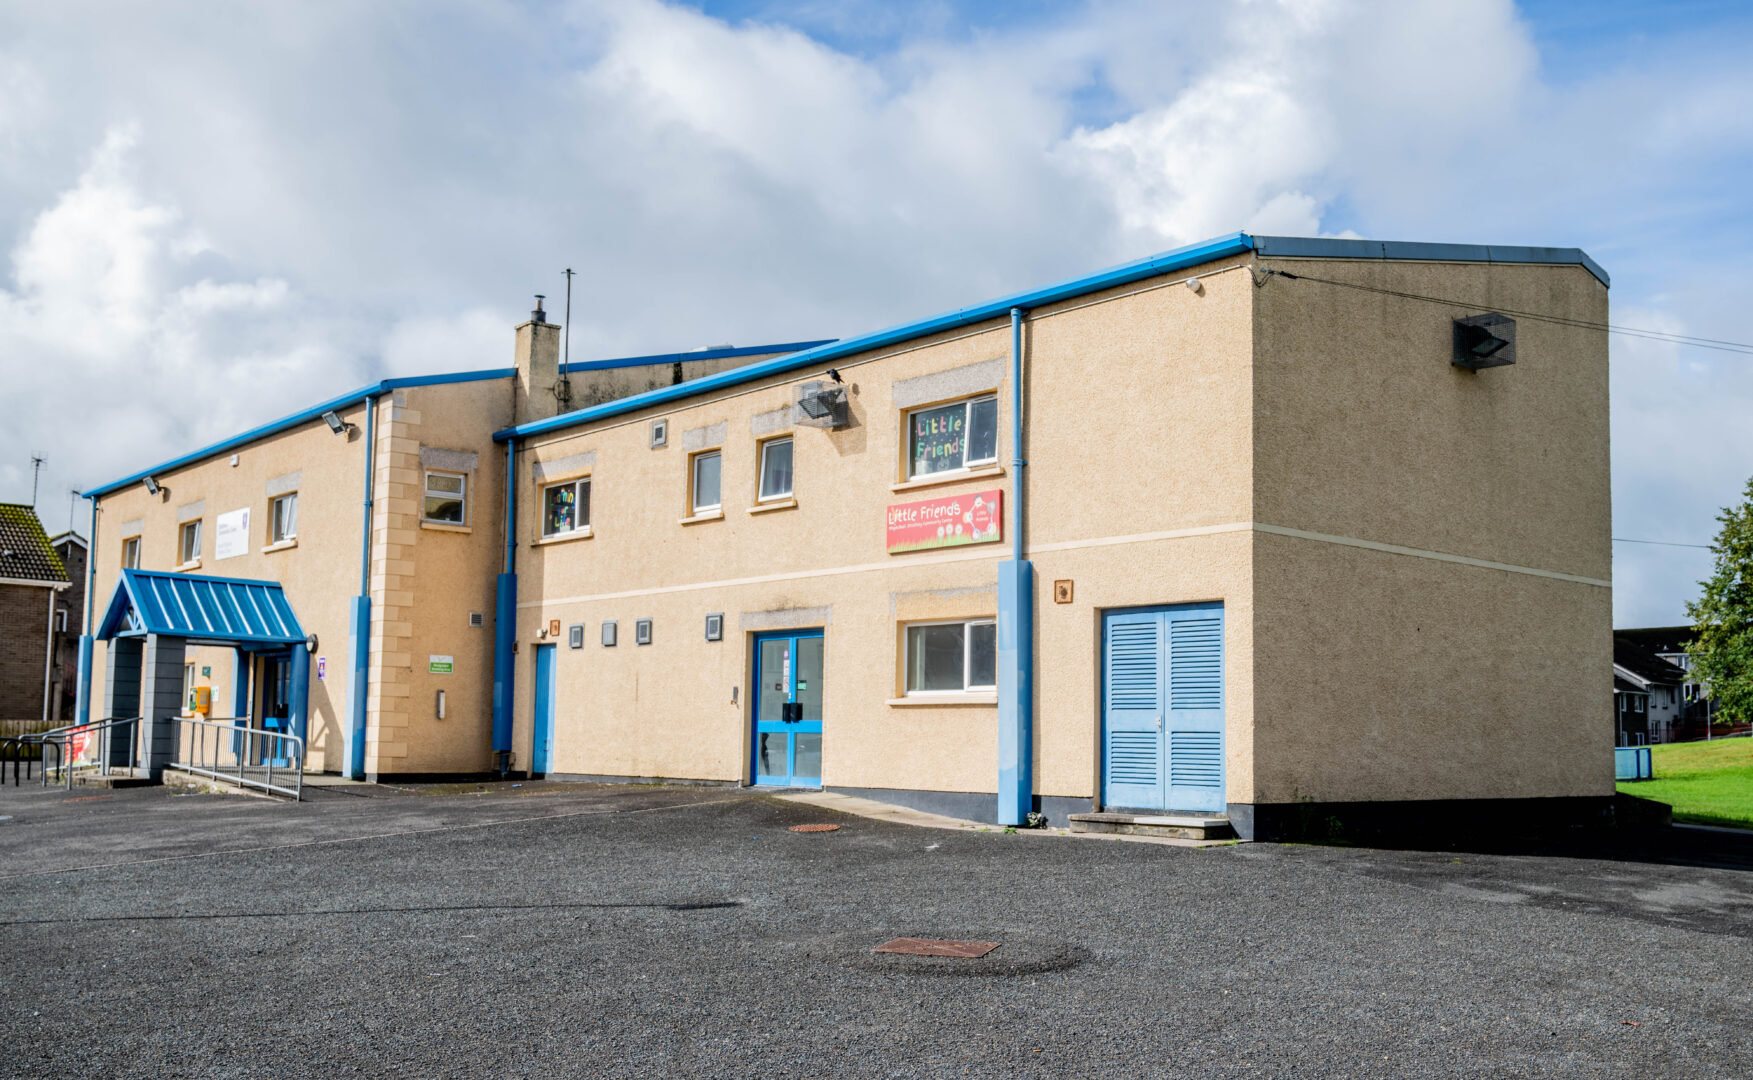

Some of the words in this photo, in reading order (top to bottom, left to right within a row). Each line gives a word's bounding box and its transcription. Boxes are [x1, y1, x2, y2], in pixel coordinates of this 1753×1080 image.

[918, 415, 962, 436] Little
[917, 437, 965, 460] Friends
[888, 508, 917, 525] Little
[920, 502, 961, 519] Friends
